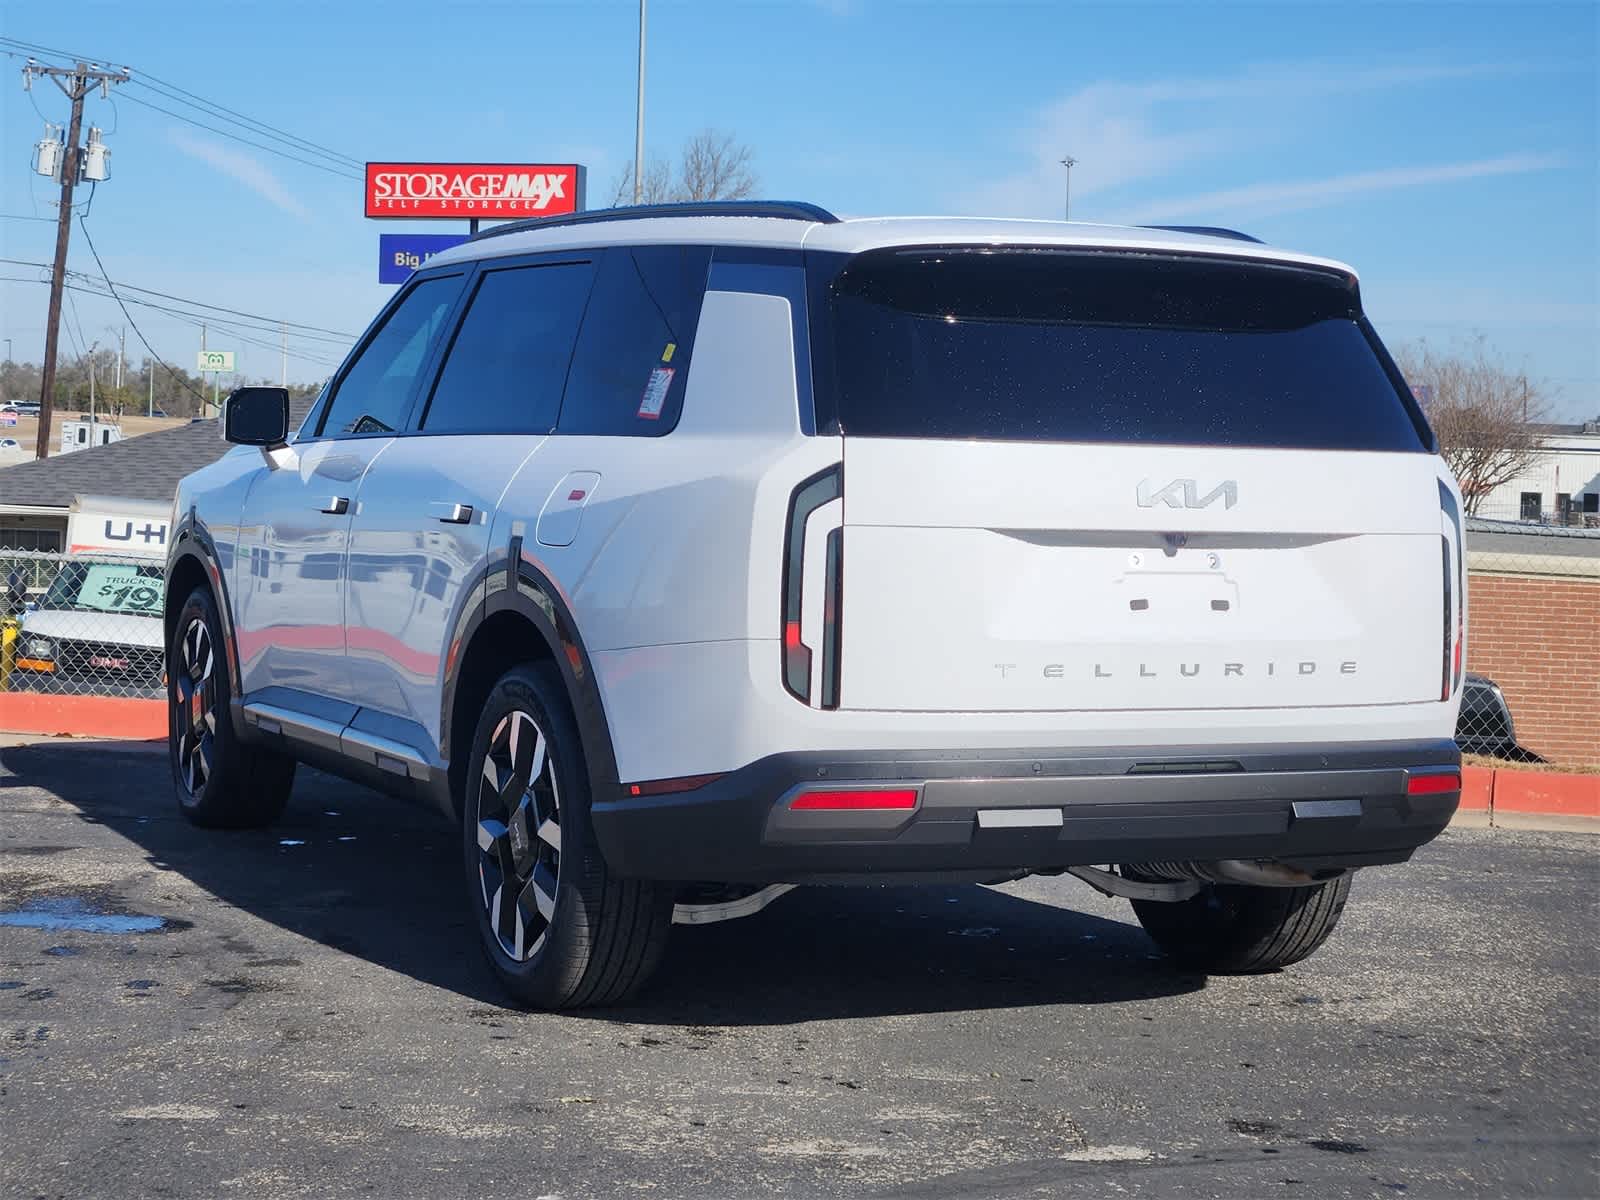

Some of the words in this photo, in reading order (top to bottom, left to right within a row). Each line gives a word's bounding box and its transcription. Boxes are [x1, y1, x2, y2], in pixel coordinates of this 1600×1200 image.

[374, 173, 568, 209] STORAGEMAX
[374, 200, 420, 208] SELF
[441, 200, 530, 209] STORAGE
[394, 251, 420, 270] Big
[105, 576, 146, 585] TRUCK
[98, 585, 164, 610] $19
[994, 661, 1358, 678] TELLURIDE
